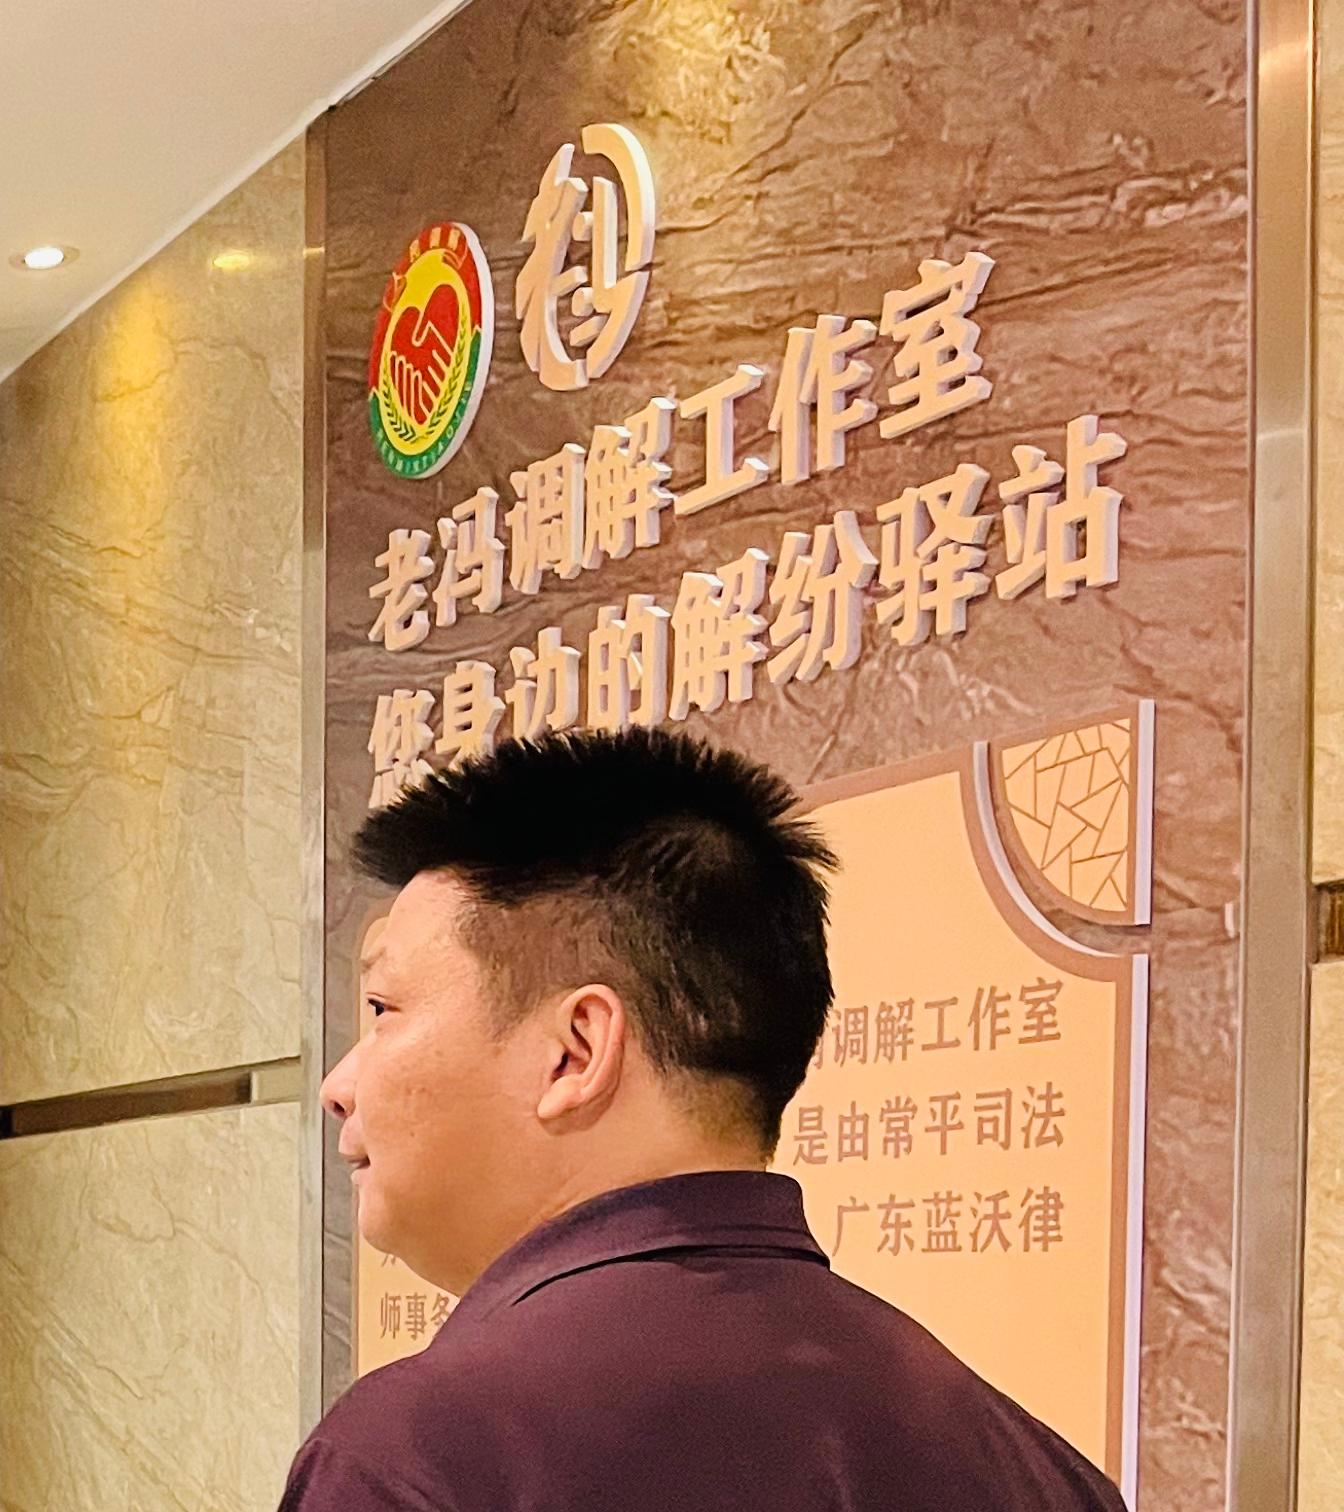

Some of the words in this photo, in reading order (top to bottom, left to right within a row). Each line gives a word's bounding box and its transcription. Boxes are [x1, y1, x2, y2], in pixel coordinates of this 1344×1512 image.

[368, 251, 996, 651] 老冯调解工作室
[367, 415, 1128, 809] 您身边的解纷驿站
[792, 1081, 1066, 1166] 是由常平司法
[831, 1185, 1065, 1257] 广东蓝沃律
